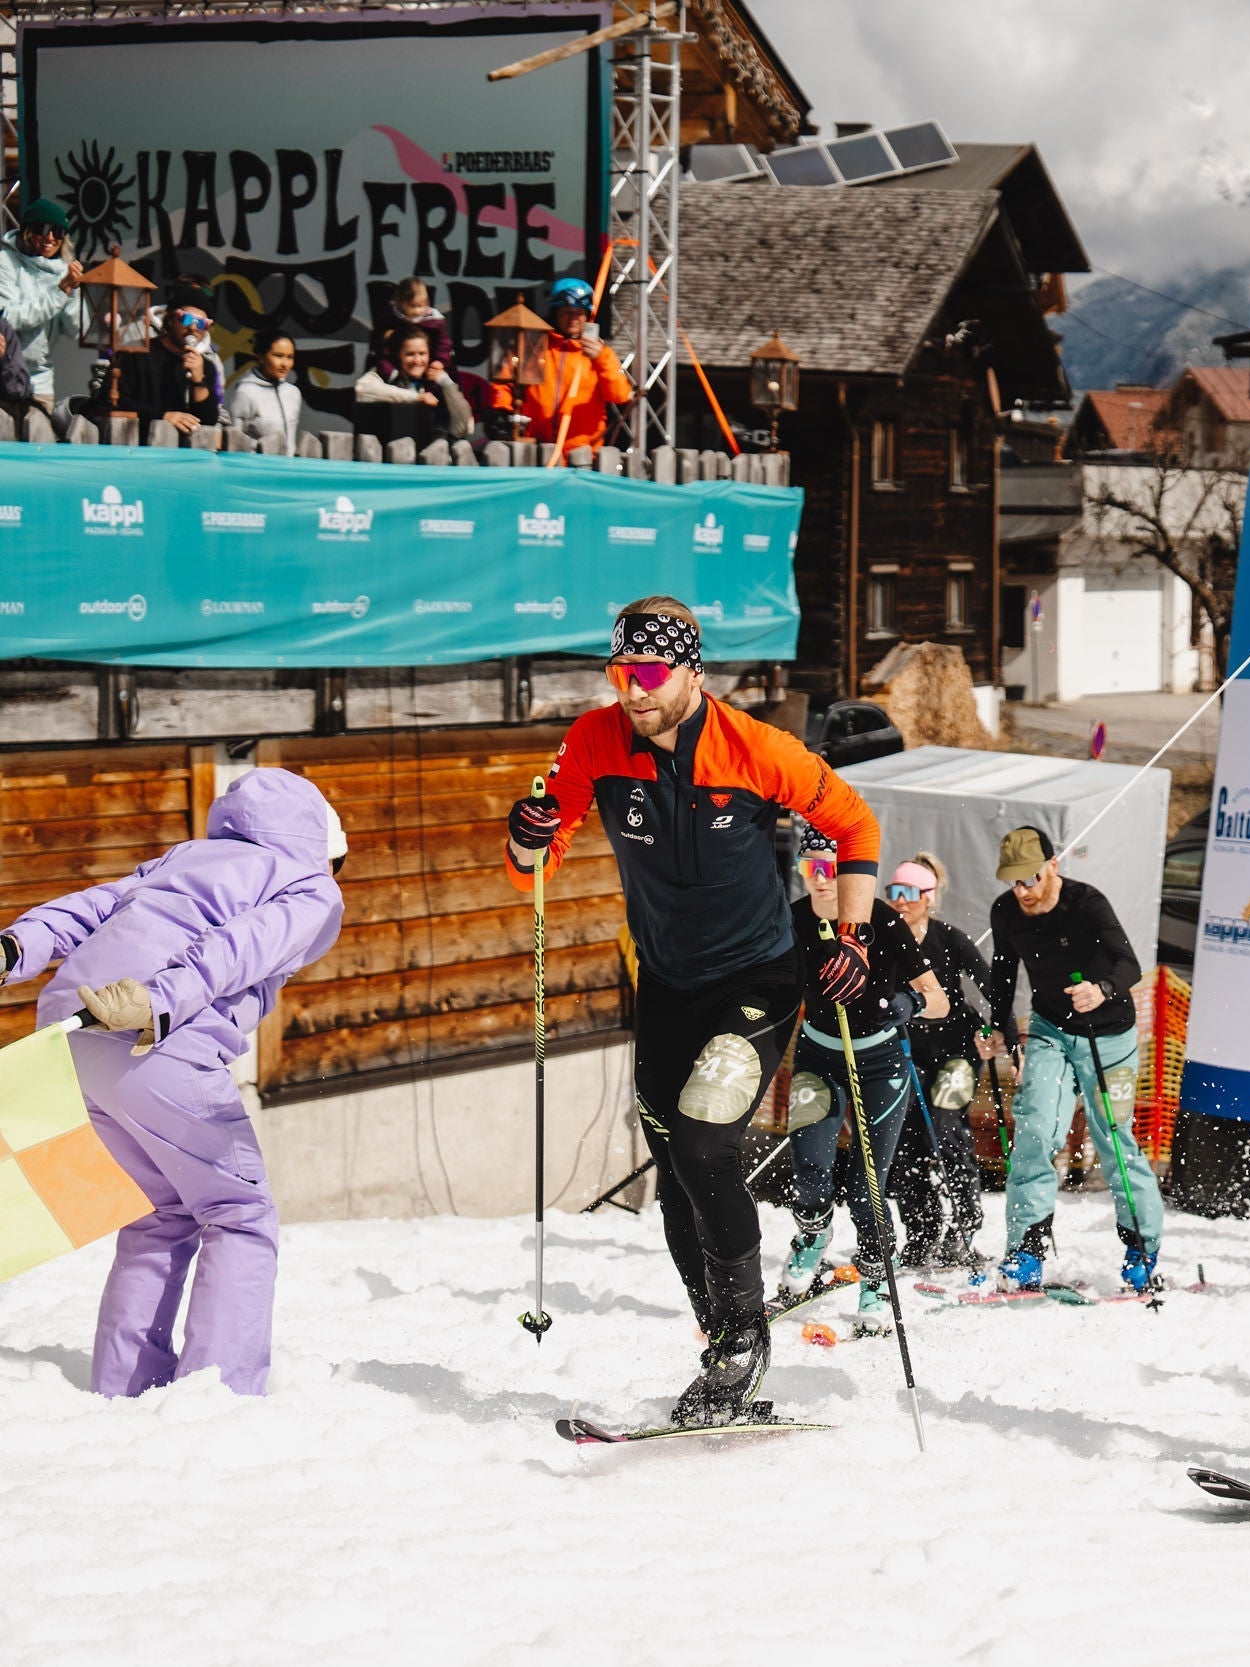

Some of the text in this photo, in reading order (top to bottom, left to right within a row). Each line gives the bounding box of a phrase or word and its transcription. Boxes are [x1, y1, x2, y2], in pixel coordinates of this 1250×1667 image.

[455, 150, 552, 173] POEDERBAAS
[136, 147, 361, 277] KAPPL
[363, 180, 557, 281] FREE
[82, 498, 144, 527] kappl
[317, 507, 373, 533] kappl
[79, 598, 128, 614] outdoor
[697, 1056, 746, 1088] 47
[1109, 1082, 1133, 1101] 52
